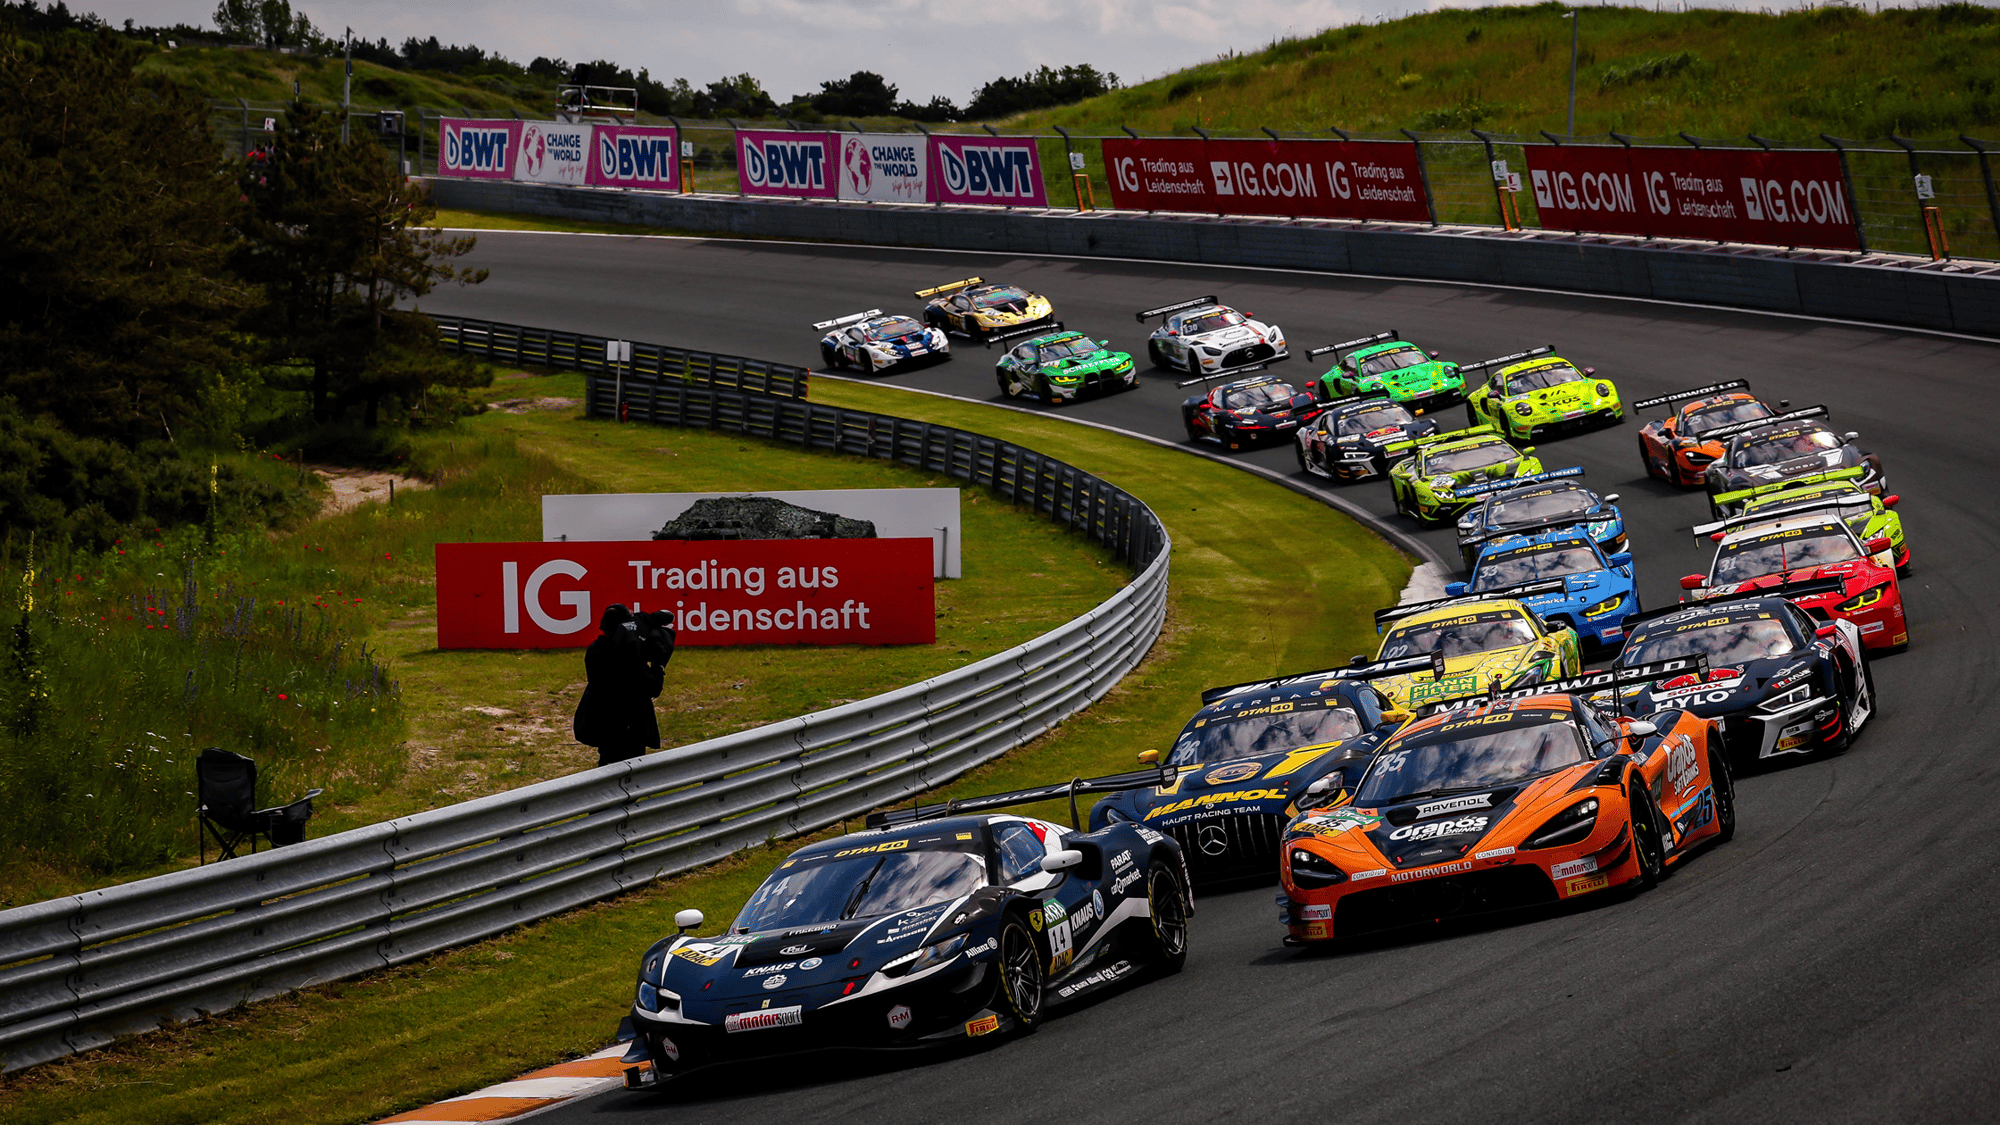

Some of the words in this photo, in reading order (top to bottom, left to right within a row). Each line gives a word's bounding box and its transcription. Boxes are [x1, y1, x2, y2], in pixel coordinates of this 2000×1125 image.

[461, 130, 509, 170] BWT
[547, 133, 581, 149] CHANGE
[553, 148, 581, 162] WORLD
[617, 137, 670, 180] BWT
[764, 142, 824, 187] BWT
[872, 146, 916, 162] CHANGE
[883, 163, 918, 177] WORLD
[964, 149, 1032, 195] BWT
[1113, 156, 1138, 193] IG
[1141, 158, 1176, 177] Trading
[1178, 161, 1194, 174] aus
[1351, 161, 1389, 183] Trading
[1391, 166, 1405, 180] aus
[1145, 178, 1206, 195] Leidenschaft
[1233, 161, 1318, 199] IG.COM
[1325, 160, 1351, 200] IG
[1670, 171, 1704, 196] Trading
[1705, 175, 1724, 193] aus
[1356, 184, 1417, 203] Leidenschaft
[1551, 170, 1637, 214] IG.COM
[1642, 170, 1671, 215] IG
[1759, 178, 1850, 225] IG.COM
[1677, 196, 1737, 221] Leidenschaft
[1635, 381, 1739, 408] MOTORWORLD
[1759, 532, 1785, 542] DTM
[1786, 529, 1803, 537] 40
[1515, 545, 1537, 554] DTM
[1479, 565, 1499, 579] 33
[1718, 556, 1736, 573] 31
[628, 559, 766, 597] Trading
[776, 565, 839, 589] aus
[502, 558, 592, 636] IG
[1458, 615, 1477, 625] 40
[1677, 621, 1707, 632] DTM
[1708, 617, 1729, 627] 40
[1413, 683, 1473, 700] FILTER
[1414, 677, 1474, 692] MANN
[1667, 682, 1724, 698] SONAX
[1213, 690, 1323, 713] MERBAG
[1237, 706, 1270, 719] DTM
[1271, 702, 1294, 713] 40
[1440, 719, 1482, 733] DTM
[1482, 713, 1514, 725] 40
[1374, 749, 1412, 777] 85
[1142, 787, 1288, 822] MANNOL
[1423, 798, 1483, 815] RAVENOL
[1162, 815, 1192, 827] HAUPT
[1195, 808, 1232, 820] RACING
[1234, 805, 1261, 814] TEAM
[834, 845, 876, 858] DTM
[877, 841, 908, 852] 40
[1476, 847, 1514, 859] CONVIDIUS
[1110, 850, 1132, 871] PARAT
[1352, 869, 1385, 880] CONVIDIUS
[1390, 861, 1472, 883] MOTORWORLD
[755, 876, 791, 907] 14
[1070, 902, 1094, 931] KNAUS
[1051, 925, 1066, 952] 14
[965, 942, 990, 959] Allianz
[744, 962, 797, 977] KNAUS
[739, 1007, 801, 1031] motorsport
